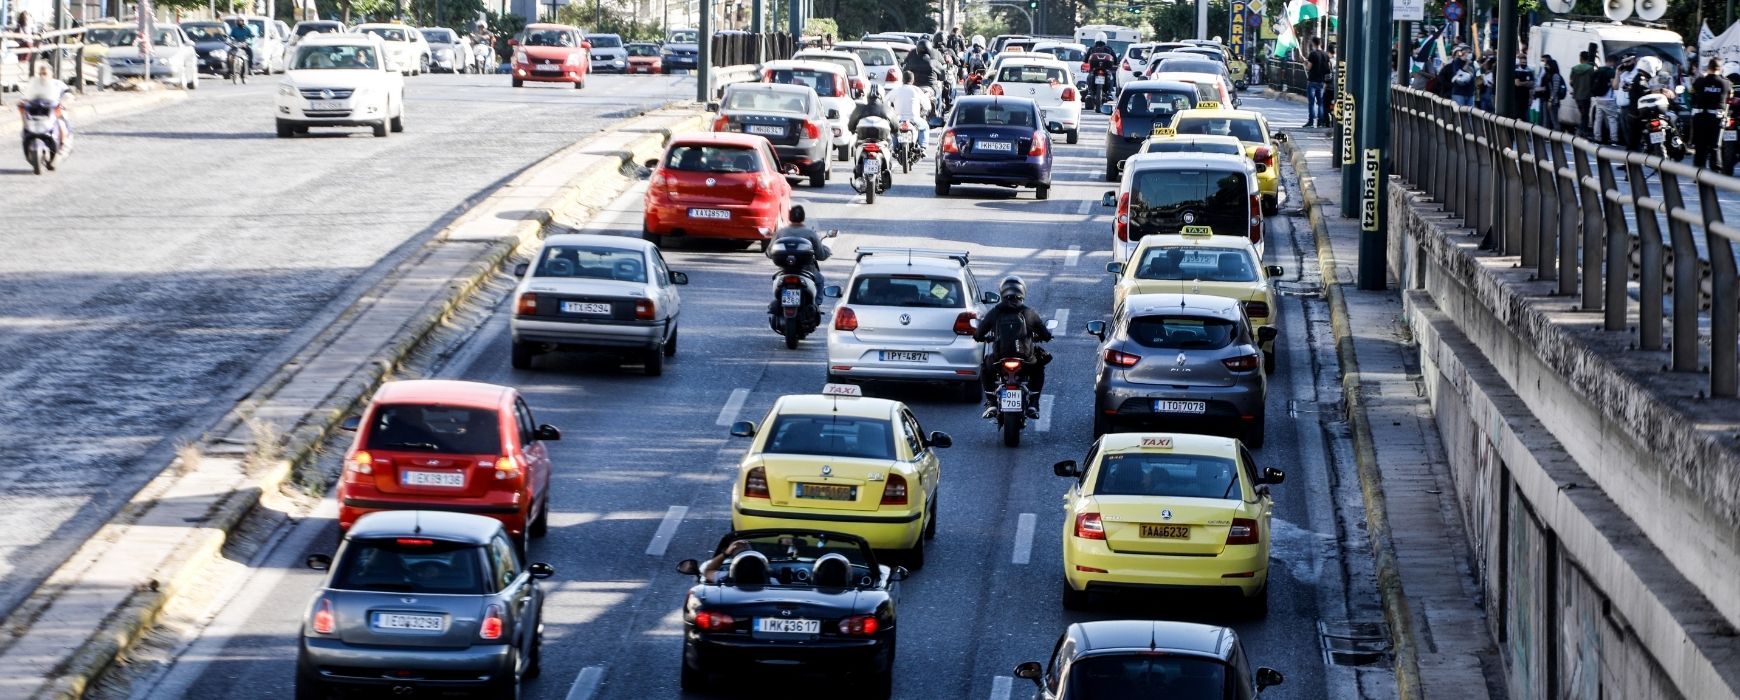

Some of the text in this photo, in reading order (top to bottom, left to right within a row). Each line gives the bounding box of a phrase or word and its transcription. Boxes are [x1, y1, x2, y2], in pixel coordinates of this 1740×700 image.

[1344, 94, 1355, 162] tzaba.gr
[1363, 152, 1379, 228] tzaba.gr
[1006, 400, 1021, 408] 705
